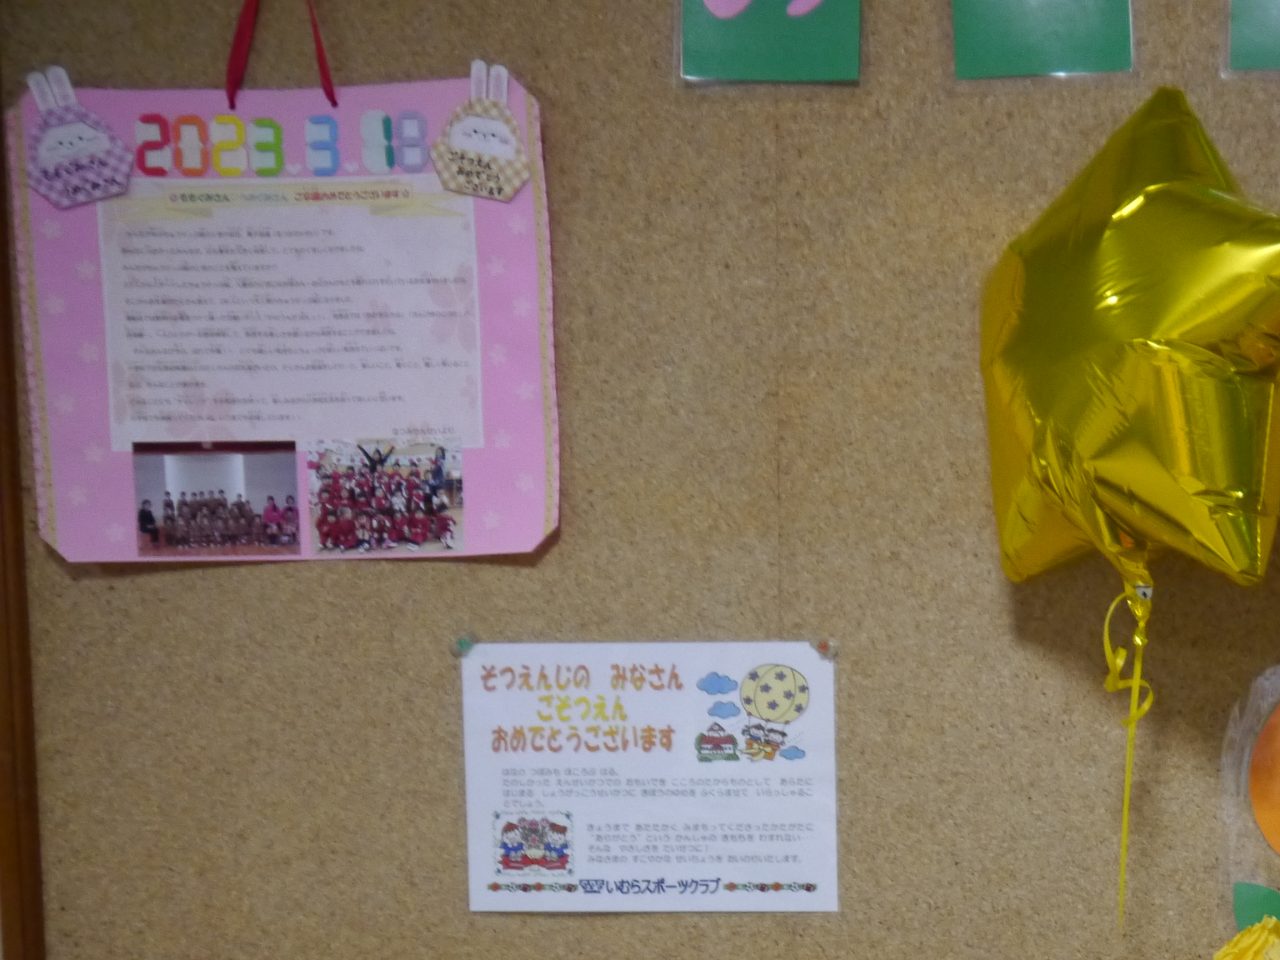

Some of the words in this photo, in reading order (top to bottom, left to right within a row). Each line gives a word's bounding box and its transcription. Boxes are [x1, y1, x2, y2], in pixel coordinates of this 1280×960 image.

[135, 113, 283, 176] 2023
[480, 664, 590, 691] そつえんじの
[610, 663, 683, 691] みなさん
[536, 695, 628, 722] ごそつえん
[492, 724, 675, 753] おめでとうございます
[606, 878, 720, 893] いむらスポーツクラブ
